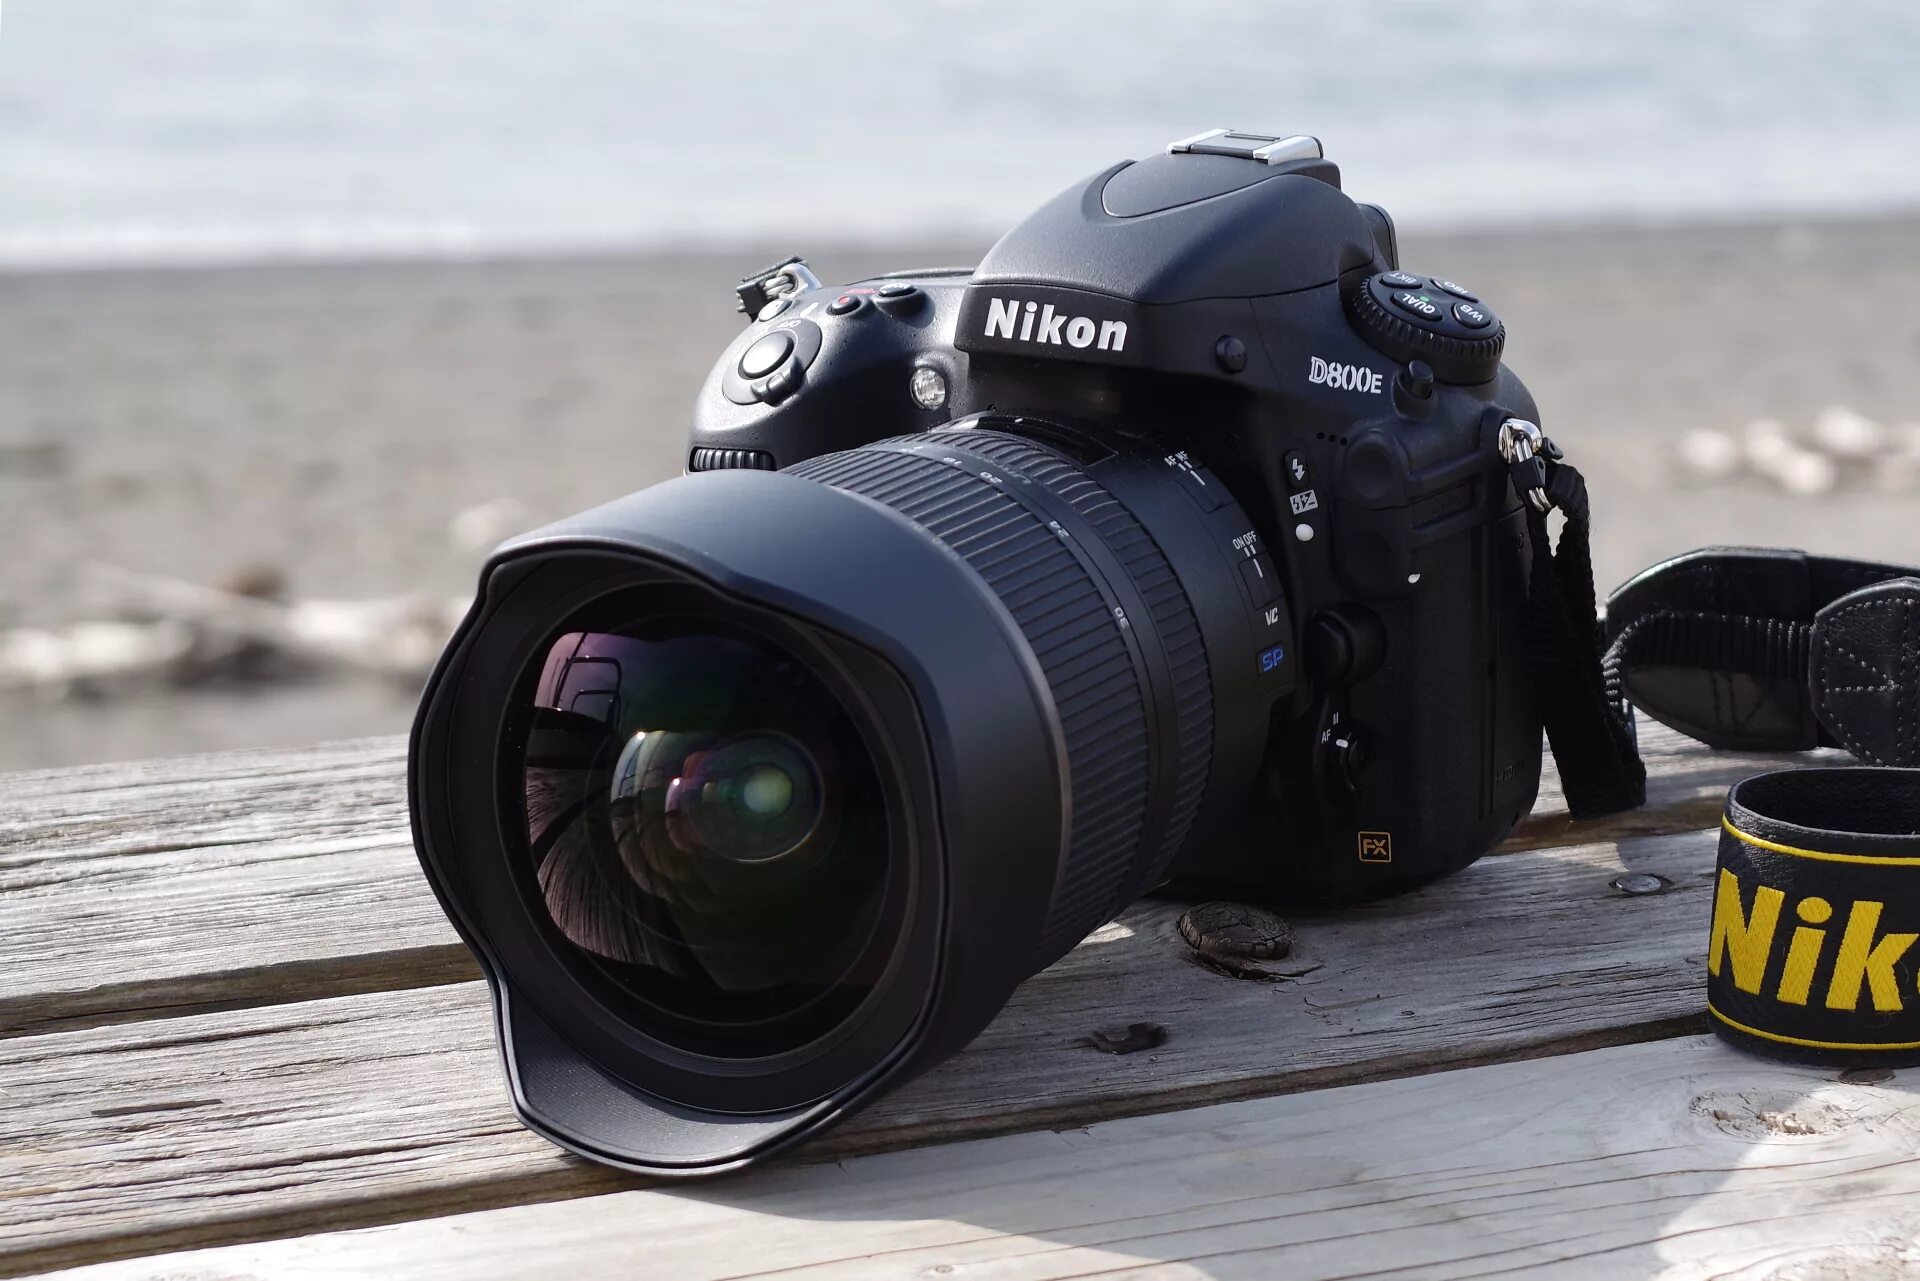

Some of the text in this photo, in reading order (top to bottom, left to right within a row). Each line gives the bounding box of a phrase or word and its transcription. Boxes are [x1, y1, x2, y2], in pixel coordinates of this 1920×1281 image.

[1389, 272, 1417, 284] BKT
[1443, 281, 1468, 294] ISO
[1402, 293, 1436, 314] QUAL
[1459, 304, 1484, 322] WB
[983, 297, 1128, 352] Nikon
[1308, 356, 1383, 394] D800E
[1164, 455, 1177, 467] AF
[979, 471, 1003, 485] 20
[1049, 520, 1070, 537] 24
[1232, 530, 1257, 550] ON OFF
[1114, 606, 1129, 628] 30
[1265, 606, 1279, 626] VC
[1261, 647, 1284, 673] SP
[1321, 728, 1331, 744] AF
[1363, 838, 1386, 856] FX
[1708, 867, 1920, 1013] Nik
